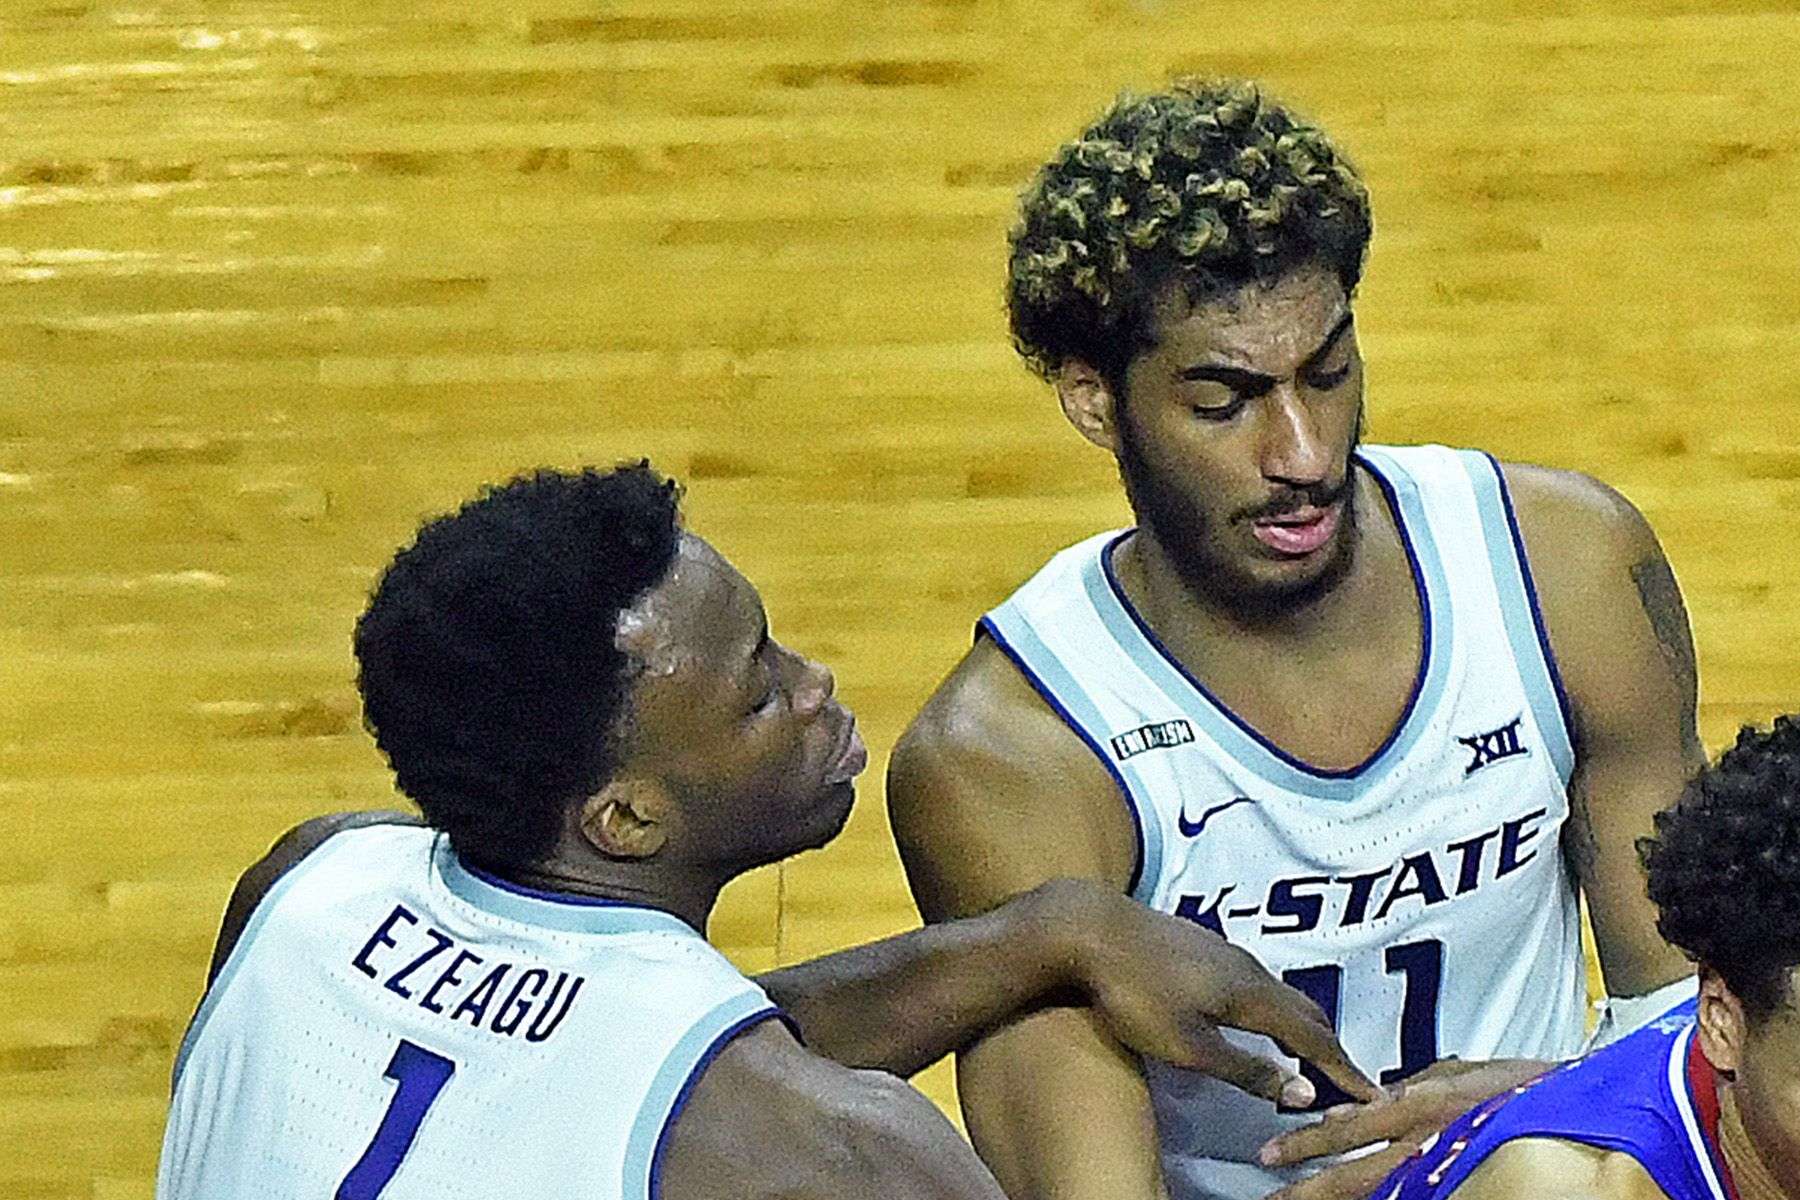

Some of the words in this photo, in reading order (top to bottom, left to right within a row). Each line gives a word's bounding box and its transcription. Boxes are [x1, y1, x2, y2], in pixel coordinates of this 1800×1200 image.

[1458, 719, 1528, 773] XII
[1173, 807, 1547, 940] K-STATE
[351, 904, 585, 1043] EZEAGU
